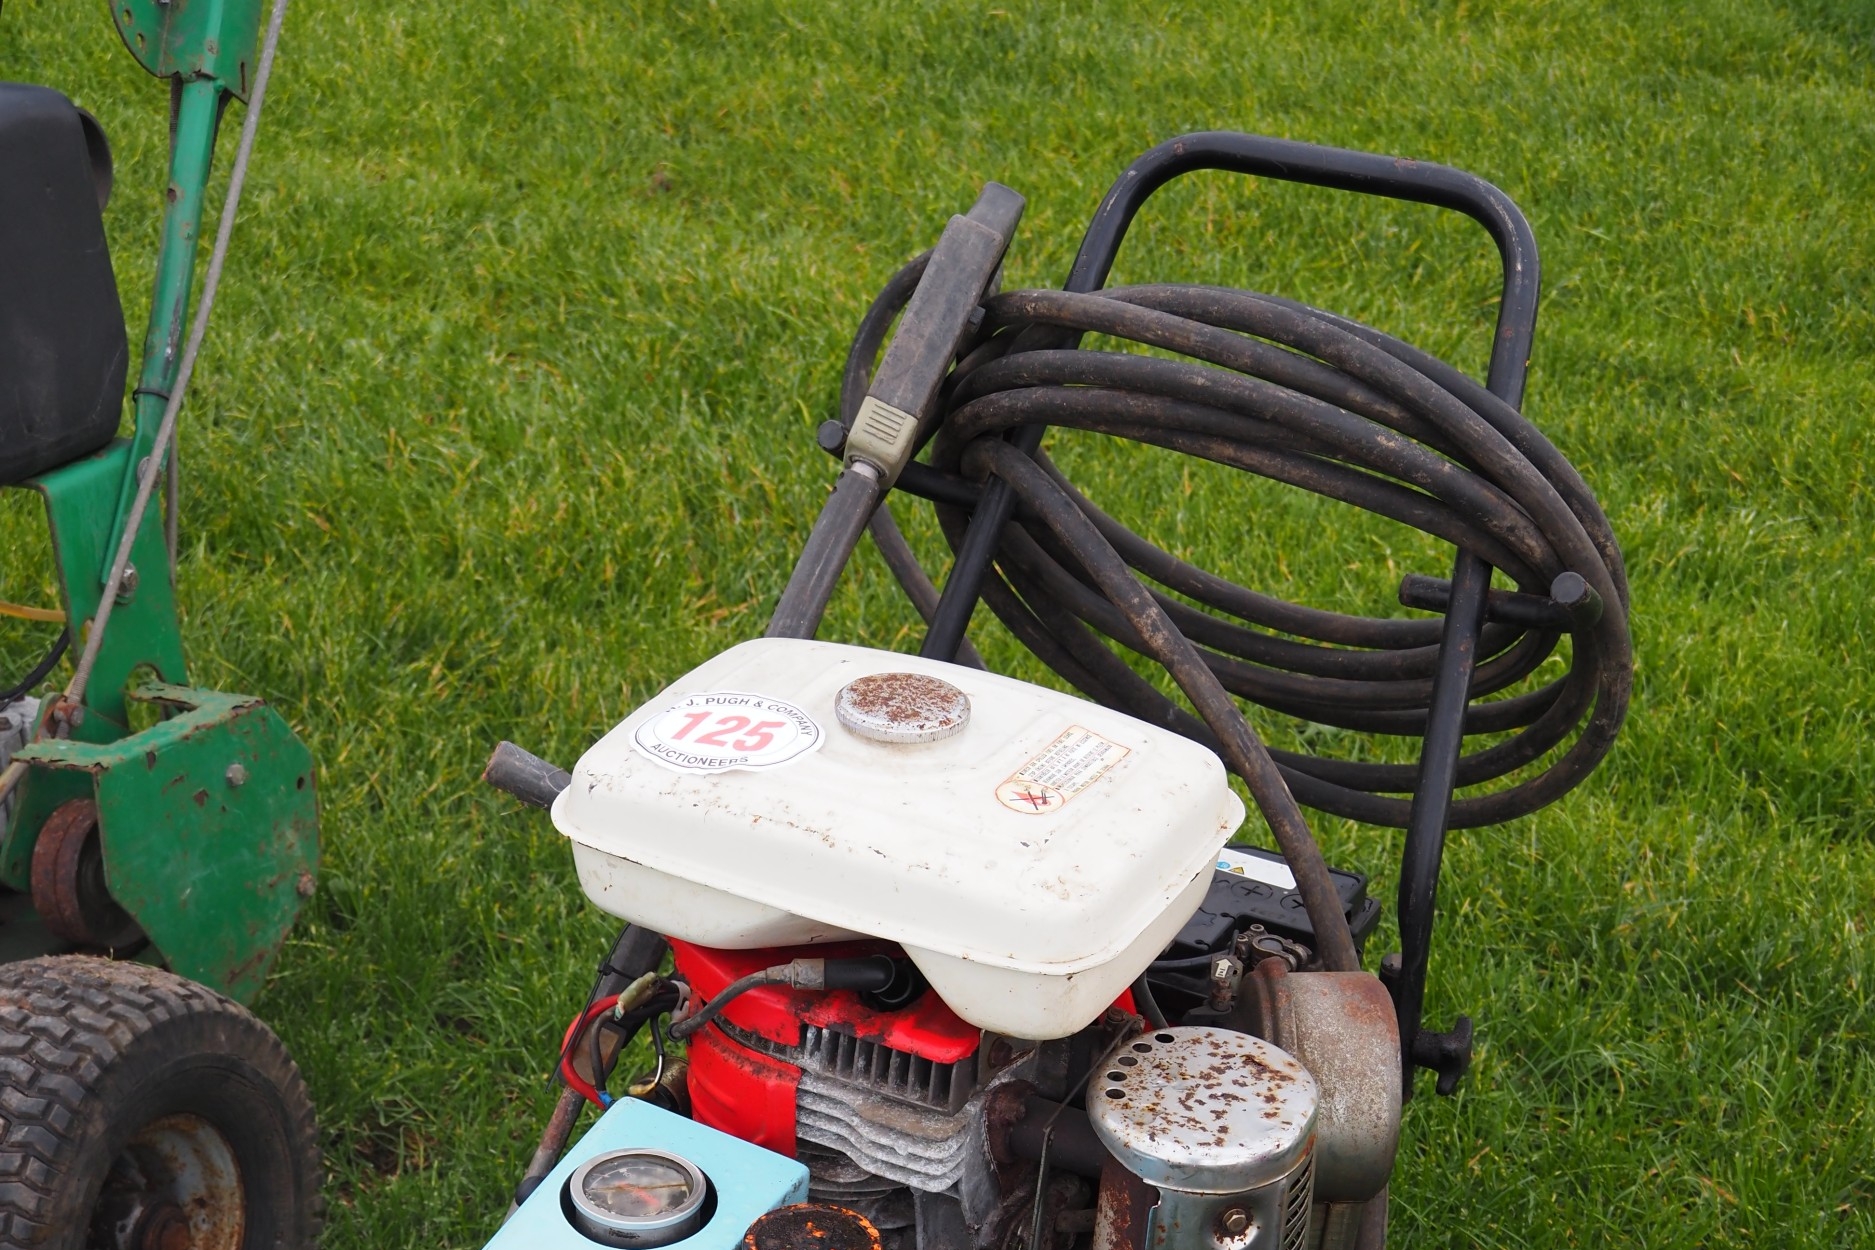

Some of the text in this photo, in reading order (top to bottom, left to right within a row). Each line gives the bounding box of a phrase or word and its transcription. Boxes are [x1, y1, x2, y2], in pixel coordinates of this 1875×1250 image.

[670, 711, 787, 751] 125
[705, 697, 750, 706] PUGH
[753, 700, 764, 708] &
[767, 704, 813, 736] COMPANY
